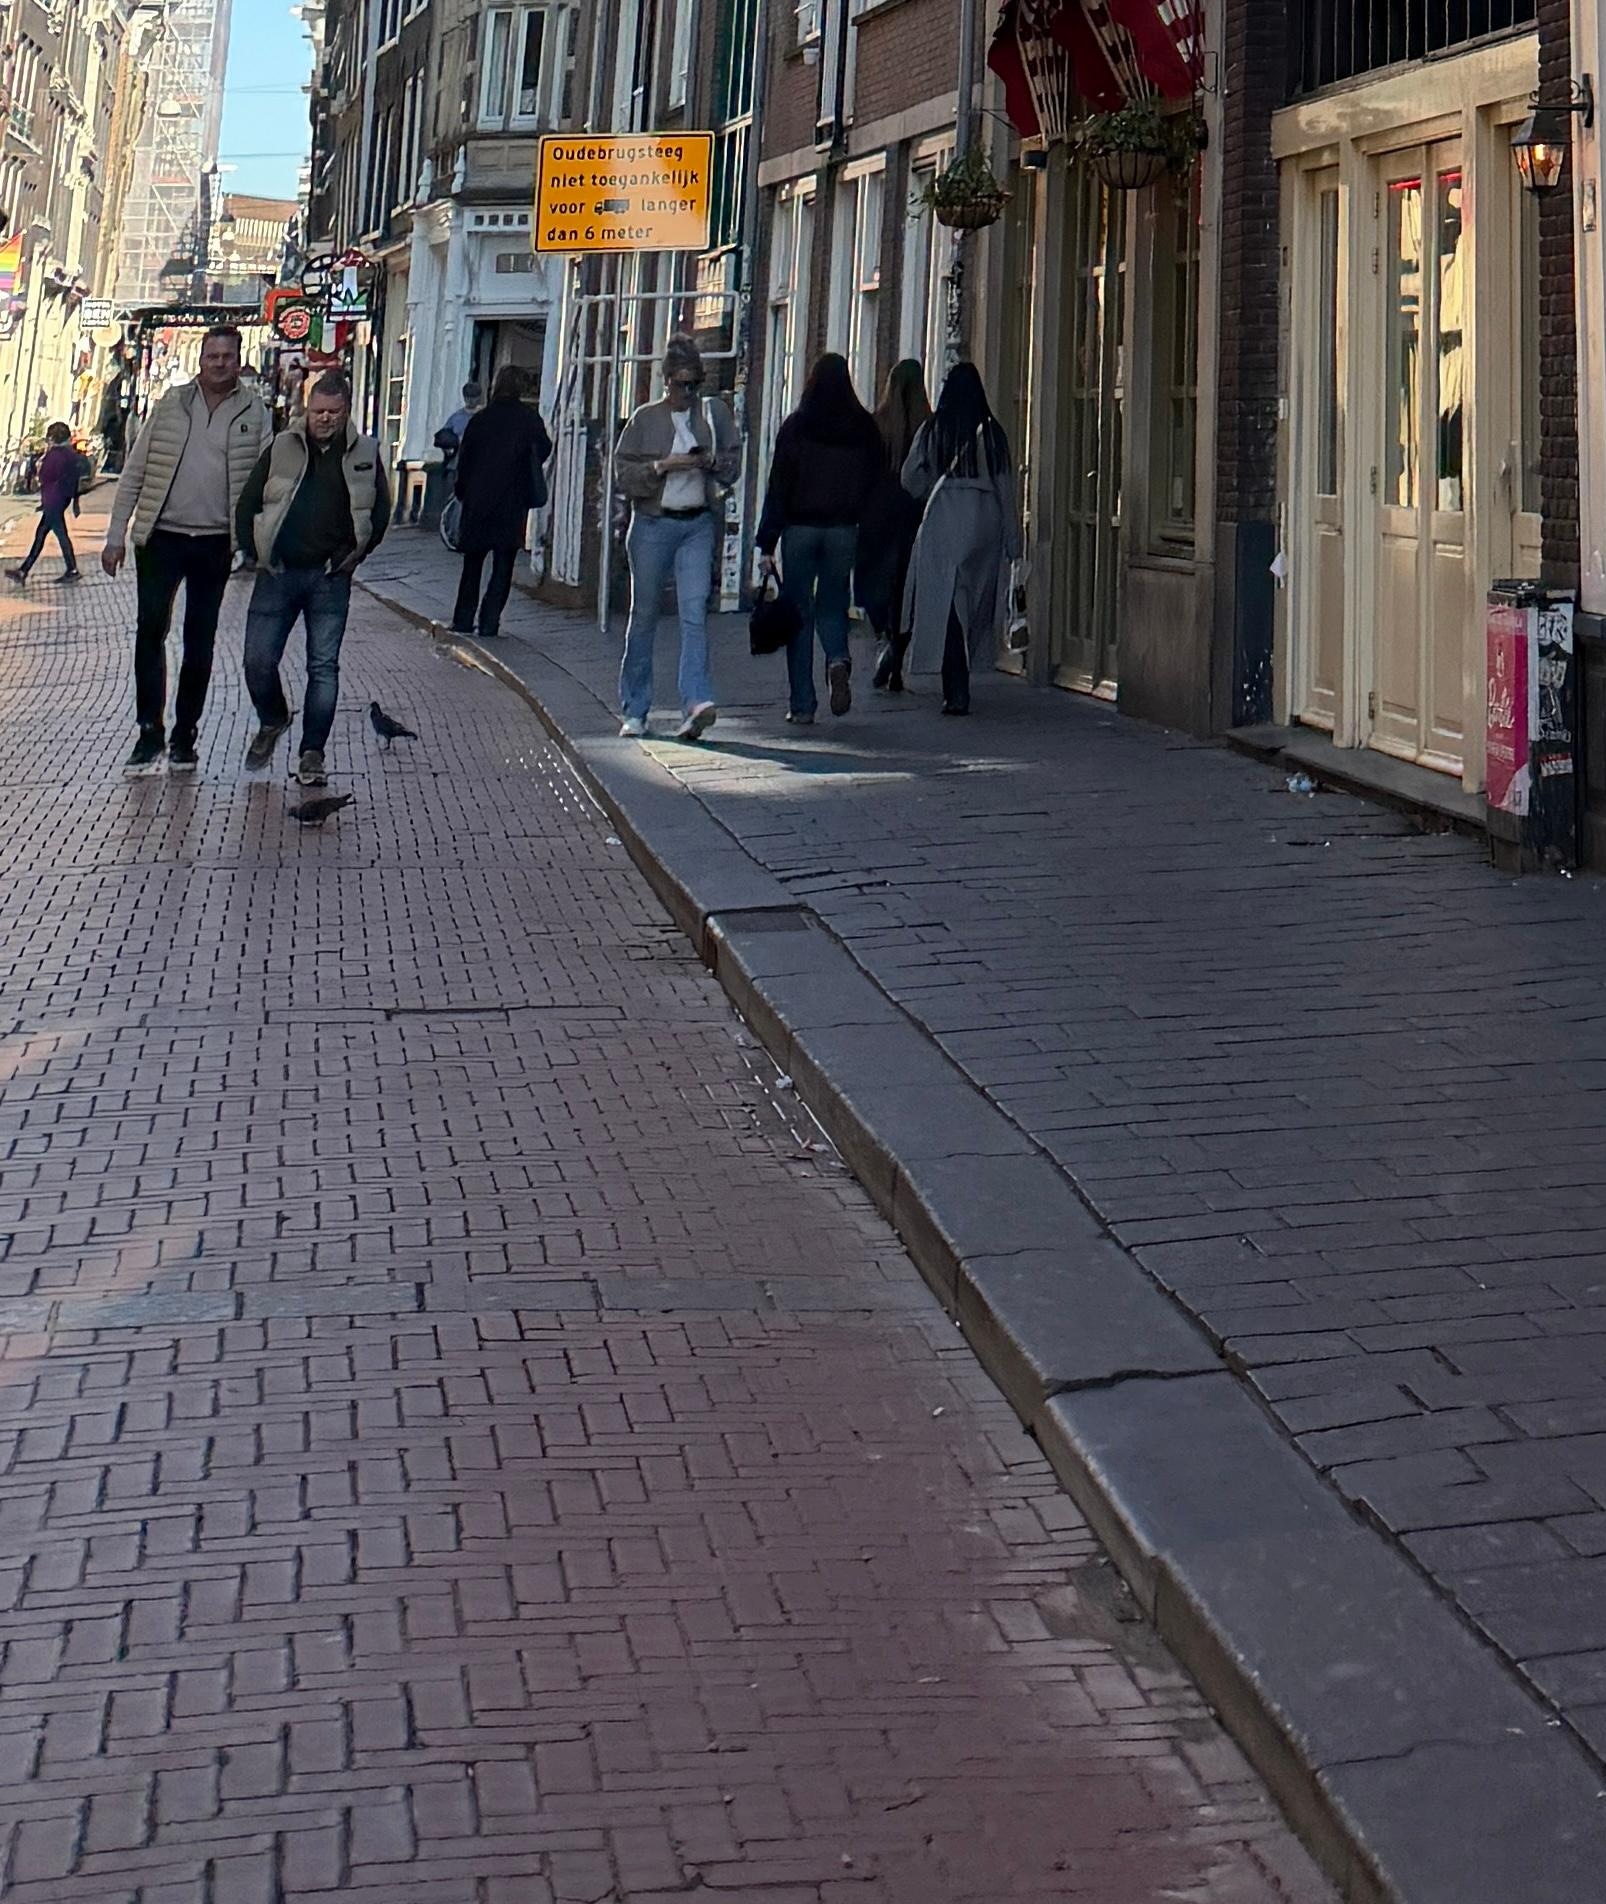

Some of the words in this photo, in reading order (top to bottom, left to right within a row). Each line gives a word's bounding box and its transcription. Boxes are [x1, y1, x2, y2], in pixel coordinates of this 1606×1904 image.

[553, 145, 683, 163] Oudebrugsteeg
[551, 173, 585, 188] niet
[591, 170, 699, 189] toegankelijk
[550, 201, 586, 214] voor
[641, 199, 697, 215] langer
[547, 226, 578, 241] dan
[584, 225, 595, 240] 6
[601, 226, 653, 240] meter
